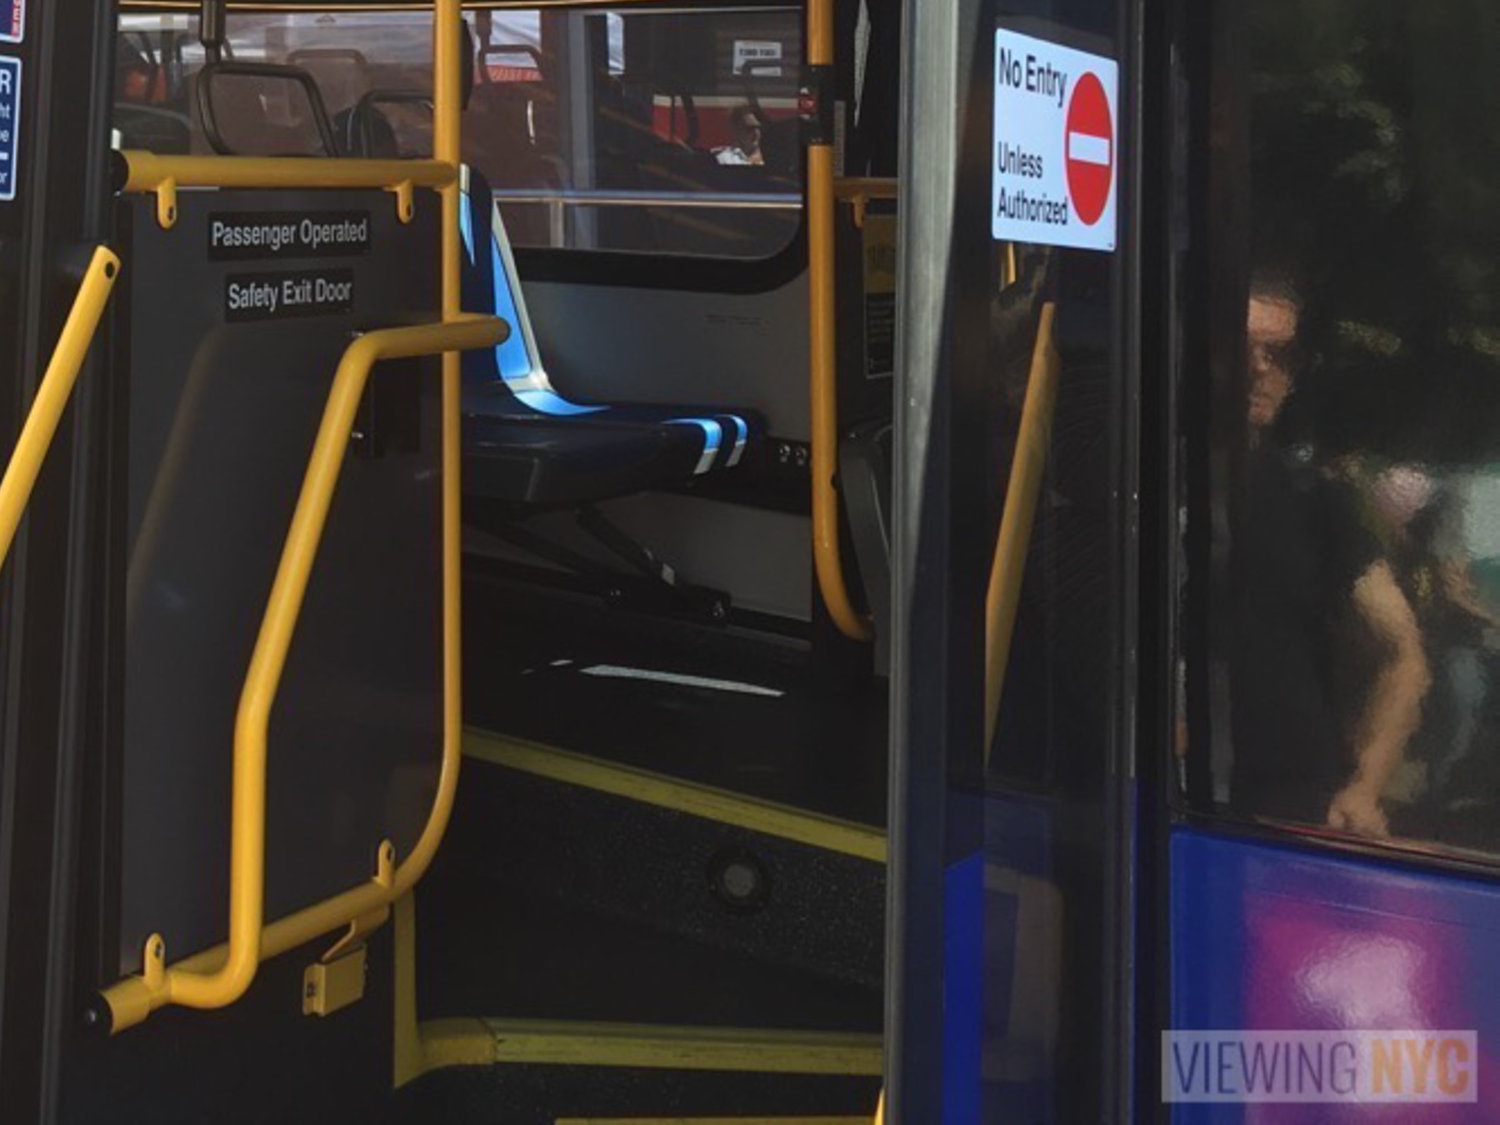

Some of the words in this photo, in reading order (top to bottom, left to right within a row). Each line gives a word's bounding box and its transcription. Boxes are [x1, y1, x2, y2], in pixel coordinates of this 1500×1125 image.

[999, 46, 1022, 88] No
[1025, 54, 1068, 108] Entry
[998, 140, 1043, 179] Unless
[997, 185, 1068, 226] Authorized
[212, 221, 297, 251] Passenger
[300, 219, 368, 249] Operated
[228, 282, 278, 313] Safety
[282, 278, 312, 305] Exit
[315, 278, 352, 302] Door
